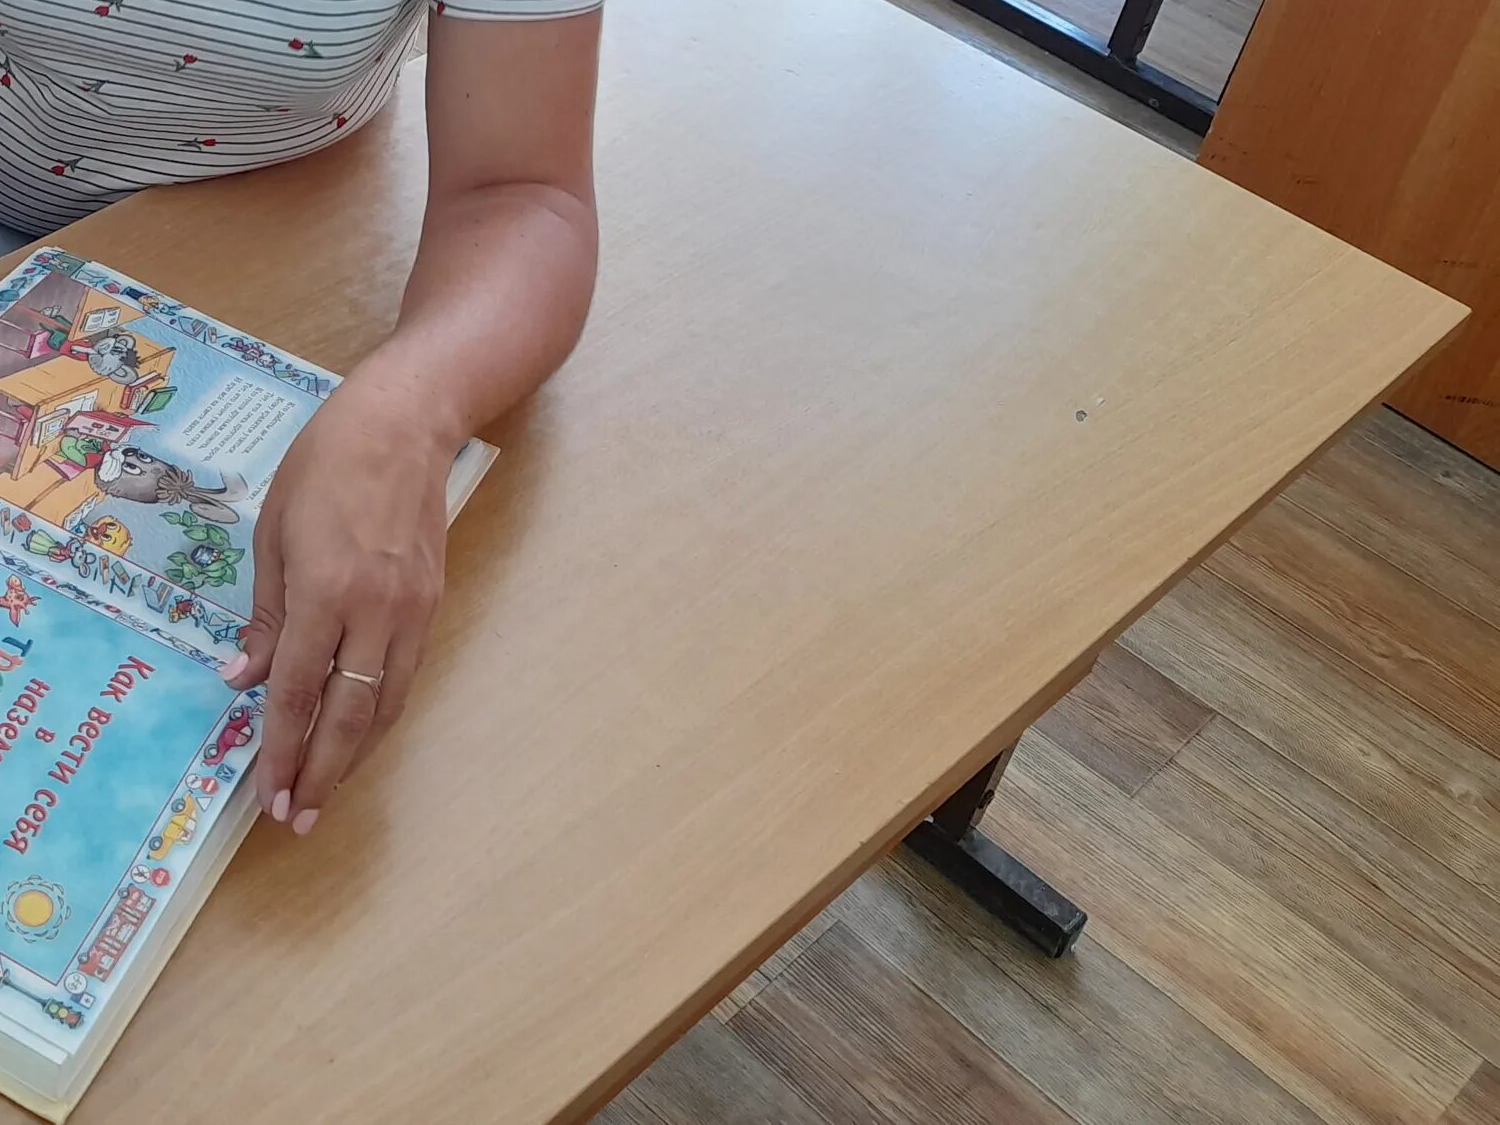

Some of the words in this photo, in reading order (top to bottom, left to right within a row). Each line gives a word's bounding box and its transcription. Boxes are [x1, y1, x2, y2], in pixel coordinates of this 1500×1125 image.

[98, 651, 155, 705] Как
[32, 724, 58, 746] в
[47, 704, 112, 785] вести
[1, 786, 58, 856] себя
